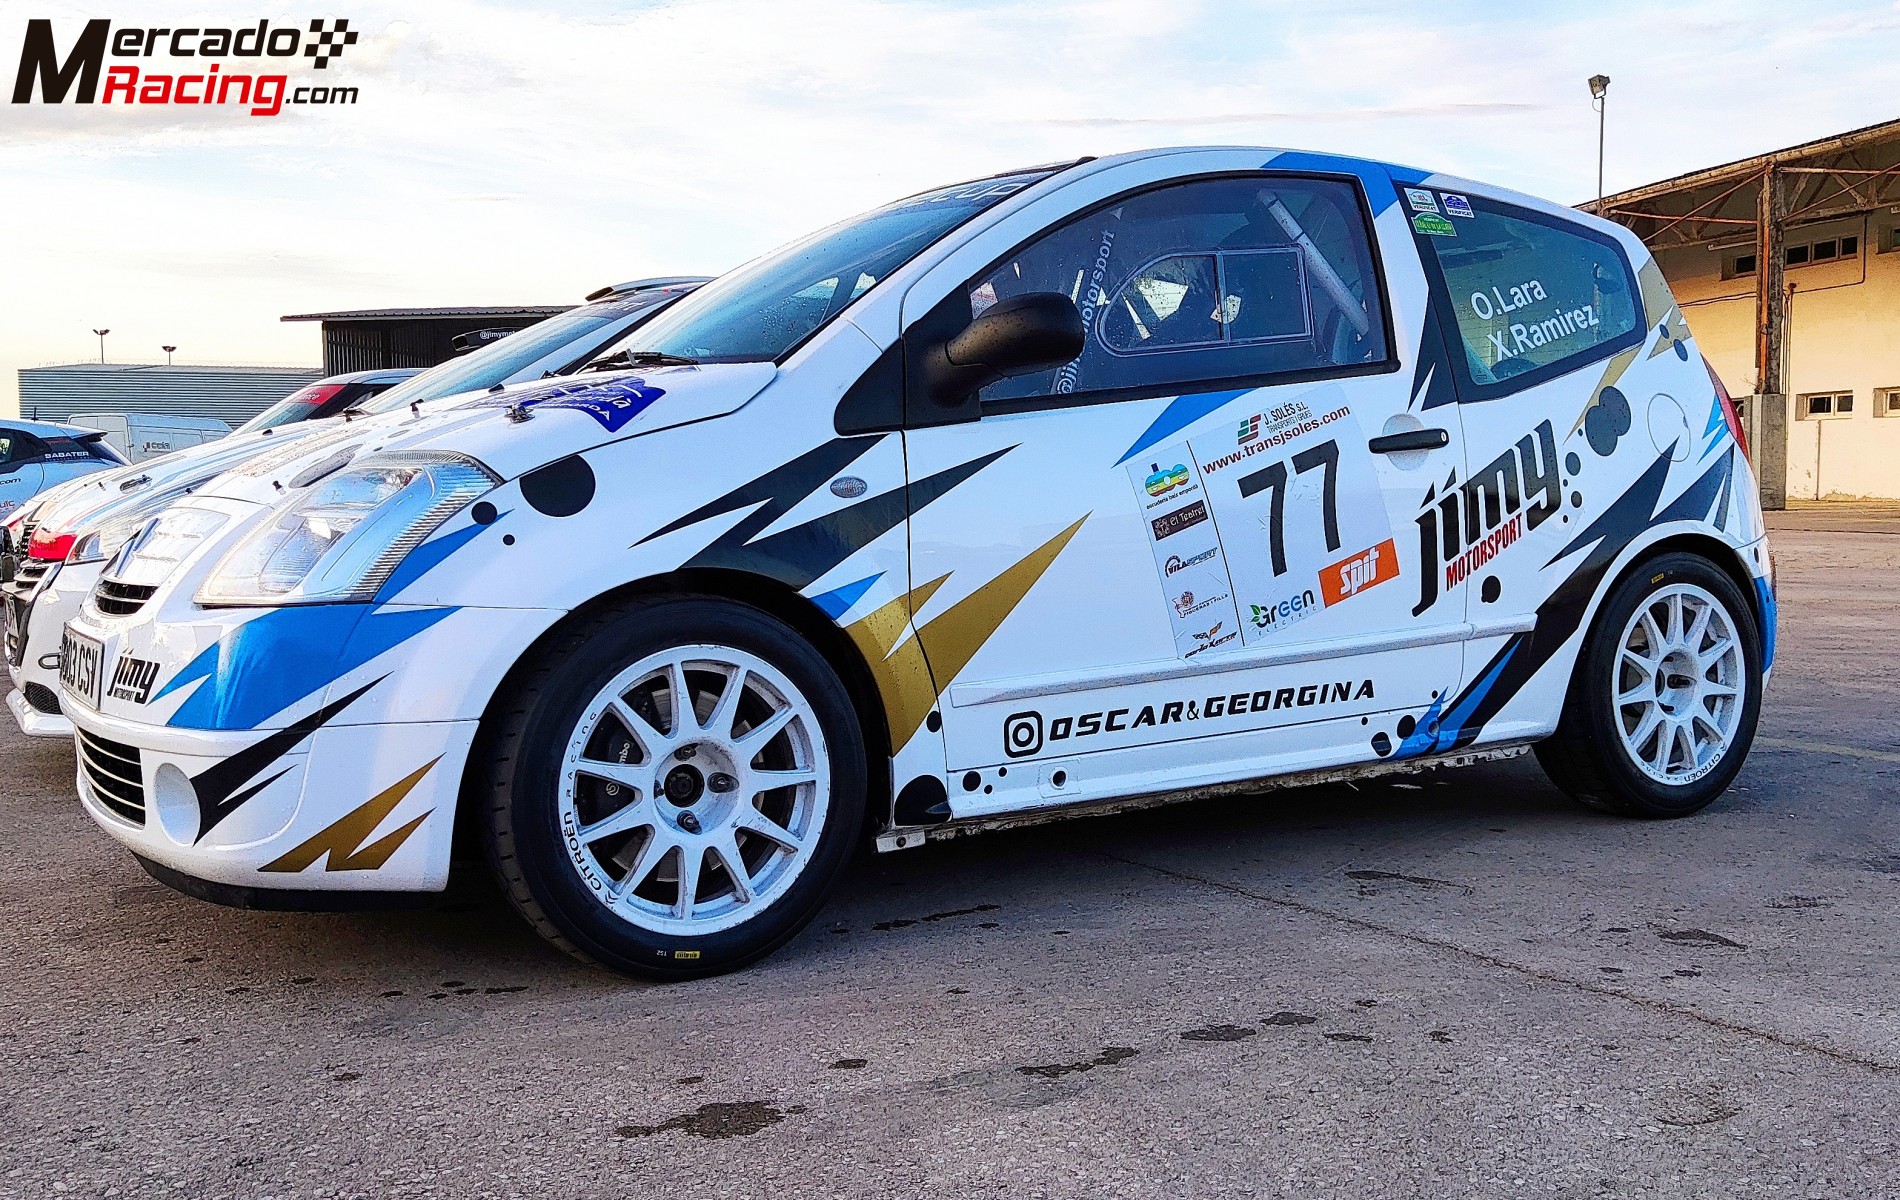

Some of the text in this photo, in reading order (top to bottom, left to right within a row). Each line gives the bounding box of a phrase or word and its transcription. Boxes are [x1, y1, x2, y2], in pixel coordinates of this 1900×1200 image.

[1470, 279, 1548, 321] O.Lara
[1486, 303, 1601, 362] X.Ramirez
[1203, 404, 1351, 475] www.transjsoles.com
[1263, 412, 1273, 426] J.
[1270, 402, 1296, 422] SOLÉS
[44, 451, 90, 459] SABATER
[1237, 438, 1341, 578] 77
[1411, 418, 1562, 618] jimy
[1446, 512, 1522, 592] MOTORSPORT
[1258, 606, 1317, 636] ELECTRIC
